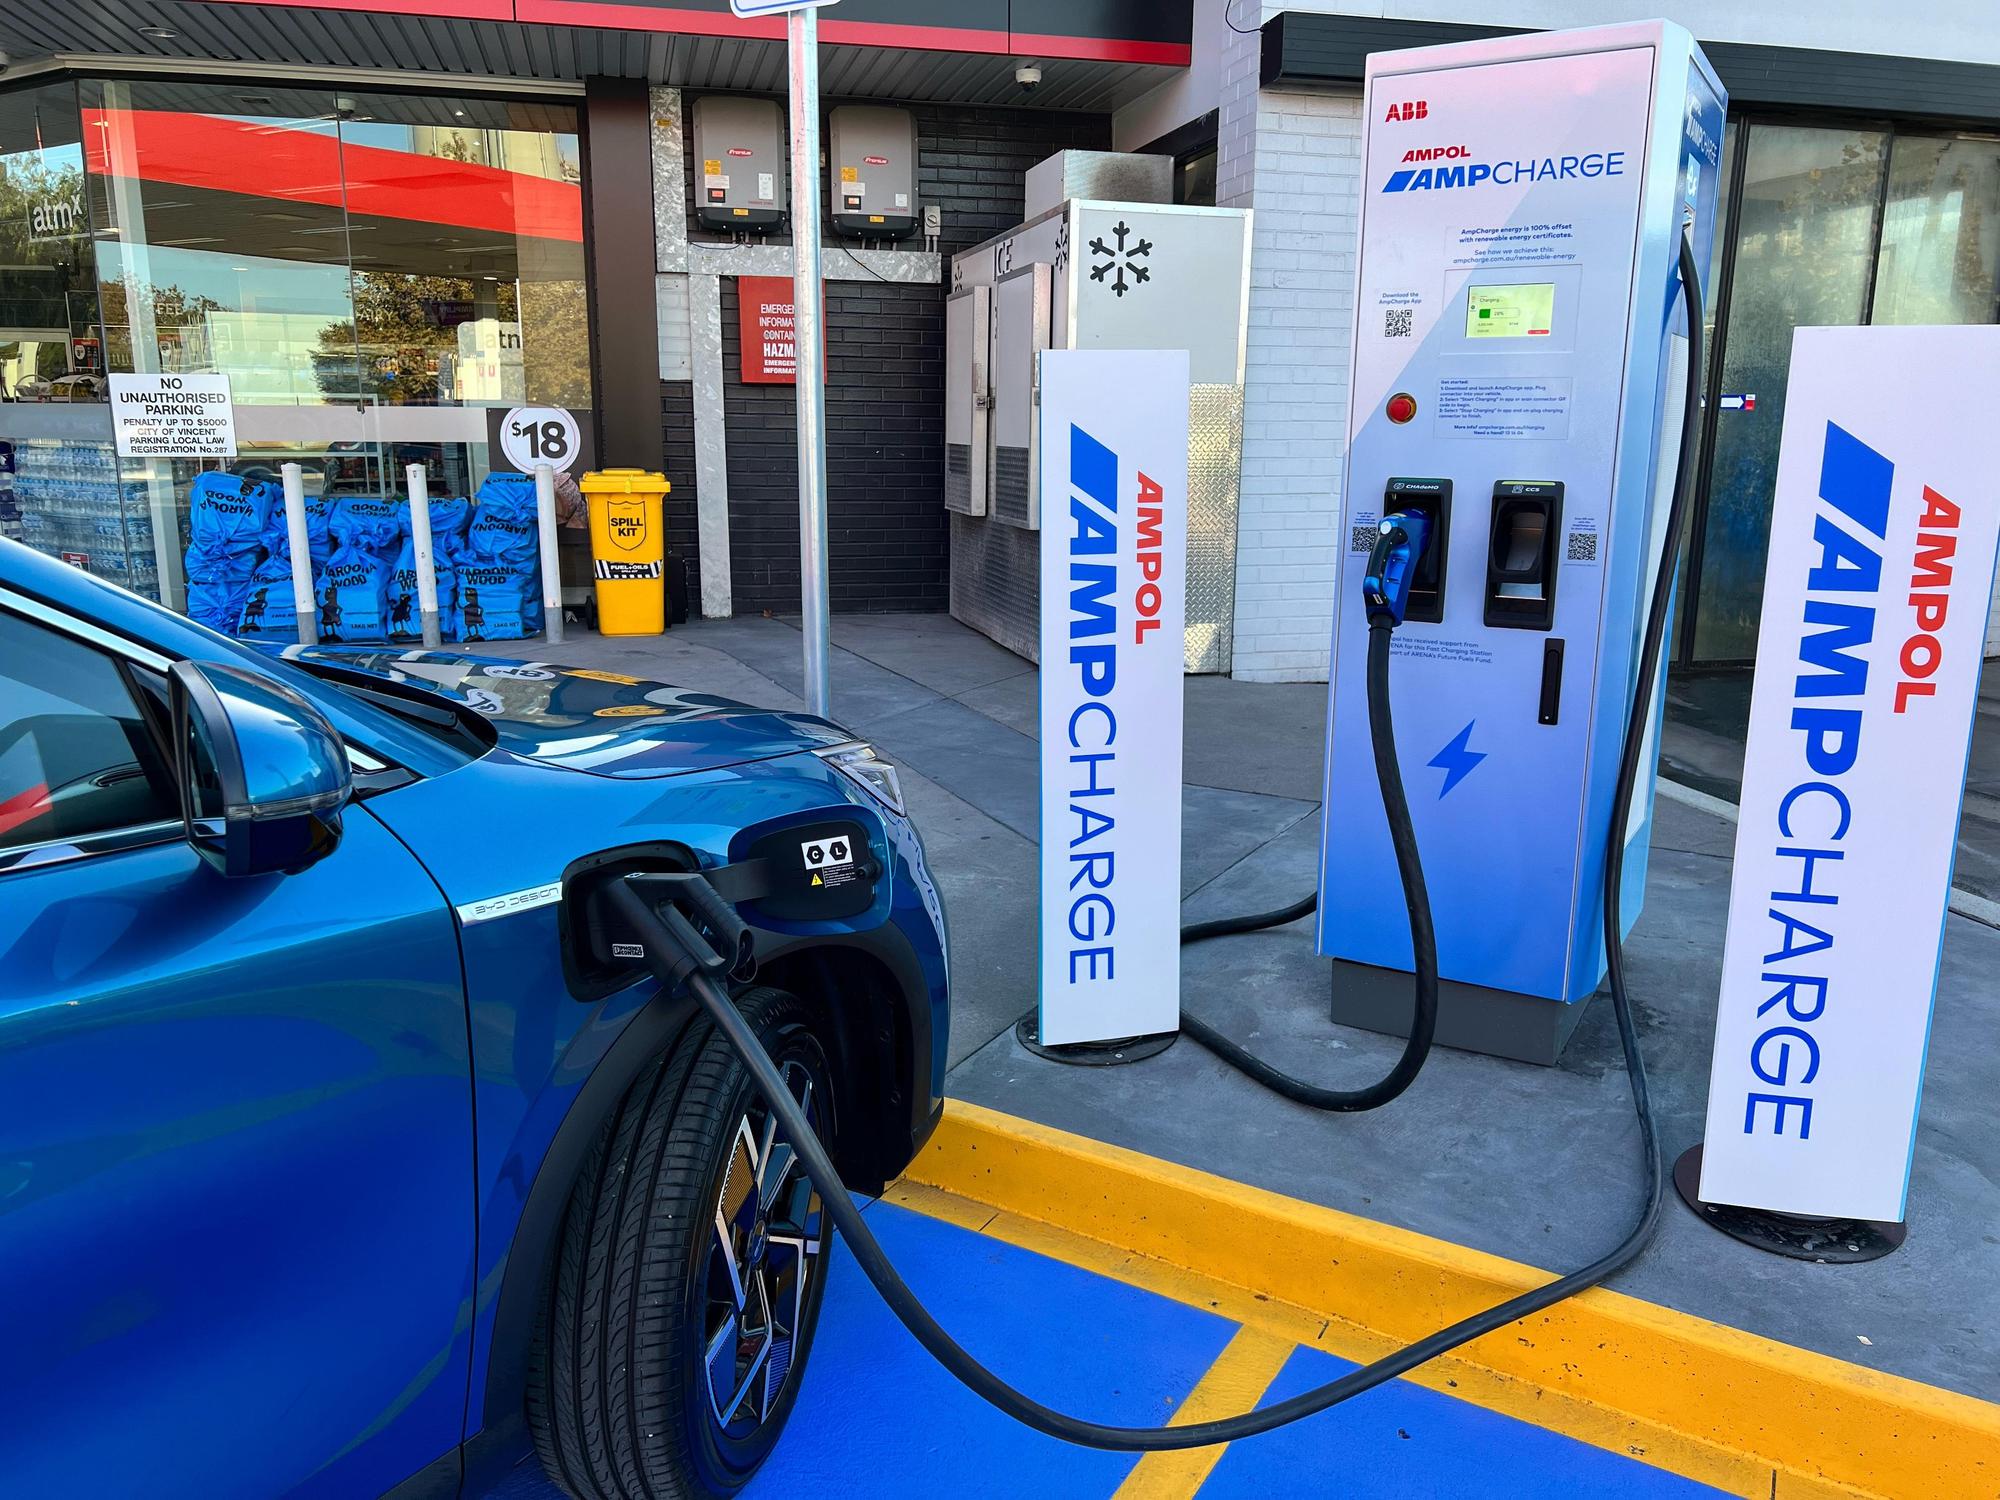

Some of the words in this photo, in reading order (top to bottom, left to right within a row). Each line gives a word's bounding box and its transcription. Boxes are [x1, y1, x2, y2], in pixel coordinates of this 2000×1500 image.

[1385, 101, 1428, 122] ABB
[1401, 145, 1471, 163] AMPOL
[1408, 151, 1625, 192] AMPCHARGE
[1461, 227, 1499, 236] AmpCharge
[1500, 226, 1522, 234] energy
[1475, 234, 1508, 242] renewable
[1509, 234, 1531, 242] energy
[1533, 232, 1573, 240] certificates.
[993, 238, 1014, 282] ICE
[761, 304, 795, 315] EMERGE
[759, 317, 795, 327] INFORMA
[763, 330, 795, 340] CONTAIN
[763, 343, 796, 357] HAZM
[160, 378, 182, 389] NO
[120, 393, 226, 403] UNAUTHORISED
[145, 405, 204, 415] PARKING
[124, 418, 162, 426] PENALTY
[183, 418, 193, 426] TO
[197, 418, 227, 426] $5000
[137, 428, 158, 436] CITY
[162, 428, 174, 436] OF
[178, 428, 216, 436] VINCENT
[206, 436, 225, 444] LAW
[511, 420, 568, 459] $18
[205, 490, 247, 504] WOOD
[610, 518, 643, 527] SPILL
[617, 527, 637, 537] KIT
[1135, 471, 1164, 645] AMPOL
[331, 574, 367, 589] WOOD
[467, 574, 507, 585] WOOD
[1893, 485, 1961, 714] AMPOL
[1067, 495, 1119, 984] AMPCHARGE
[1743, 512, 1883, 1140] AMPCHARGE
[812, 850, 820, 860] C
[835, 847, 842, 856] L
[475, 901, 506, 914] BYD
[509, 887, 559, 906] DESIGN
